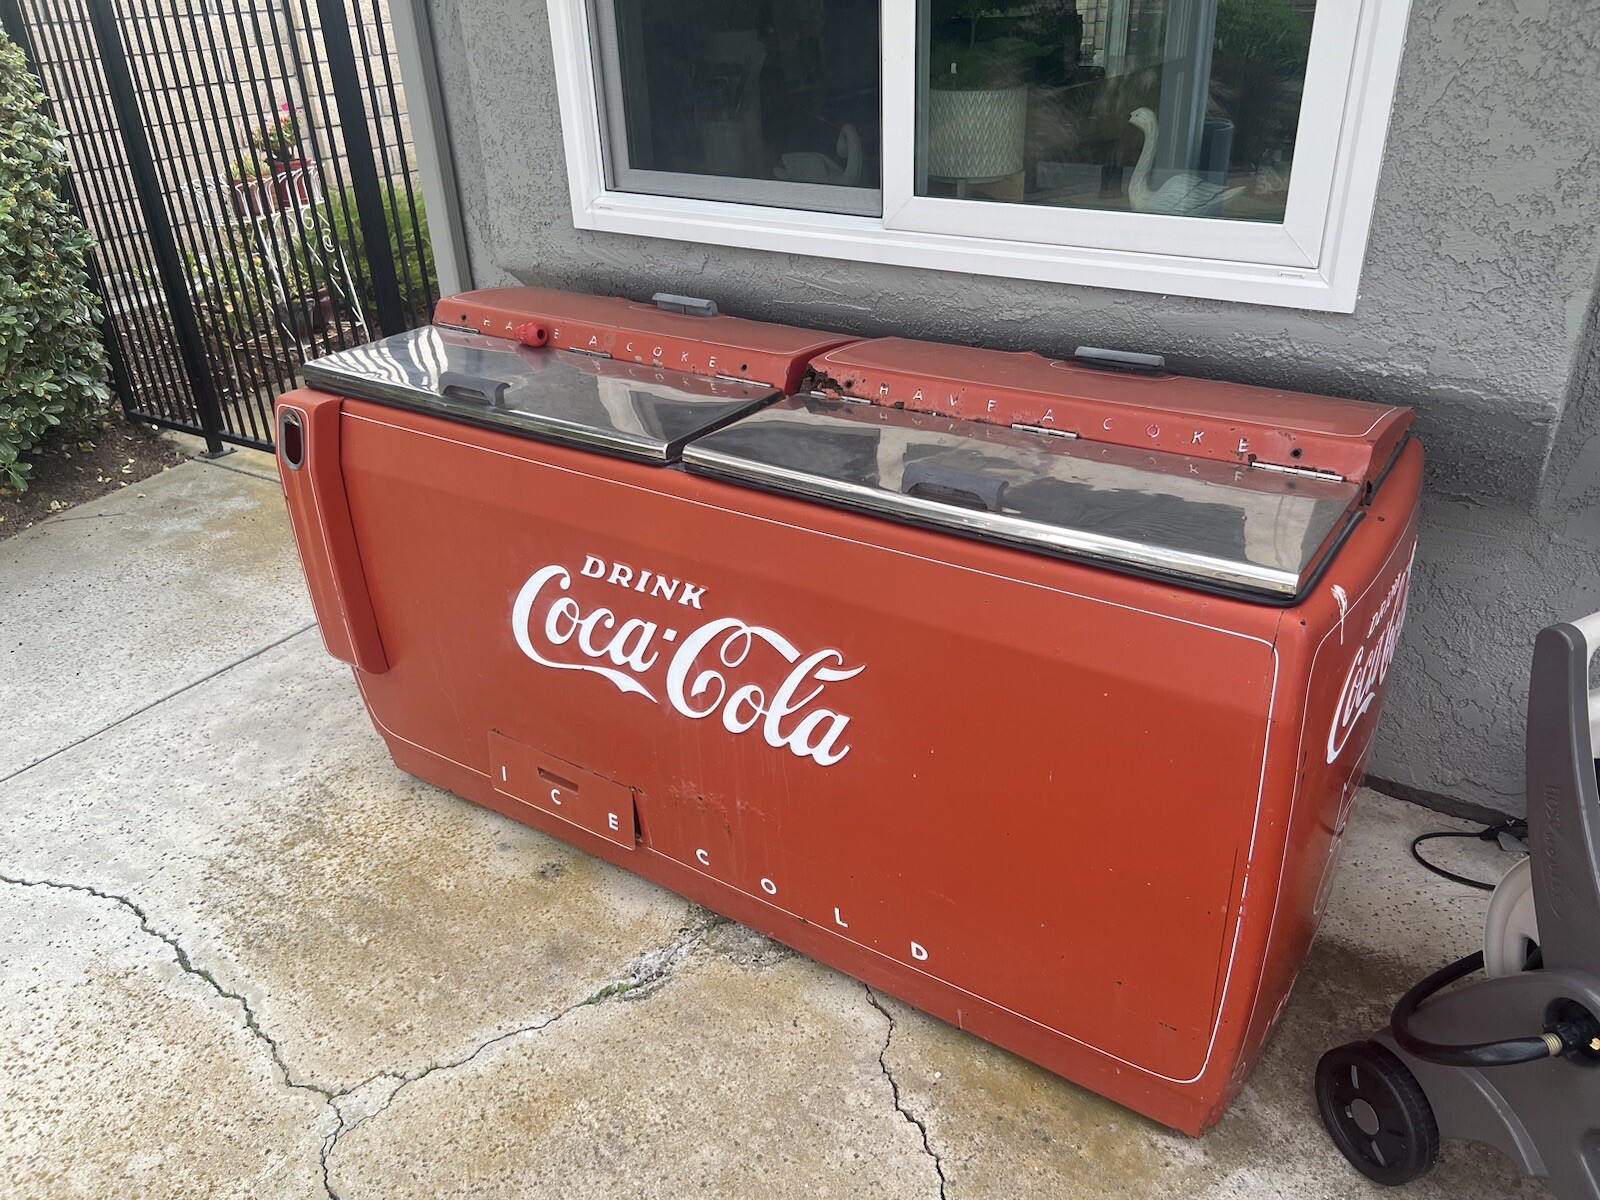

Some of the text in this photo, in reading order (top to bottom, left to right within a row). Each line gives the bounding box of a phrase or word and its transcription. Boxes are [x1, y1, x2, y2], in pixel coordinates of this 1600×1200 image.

[483, 317, 717, 368] HAE A COKE
[879, 382, 1250, 453] HAVE A COKE
[580, 554, 708, 610] DRINK
[512, 564, 866, 767] Coca-Cola
[501, 765, 929, 961] ICE COLD
